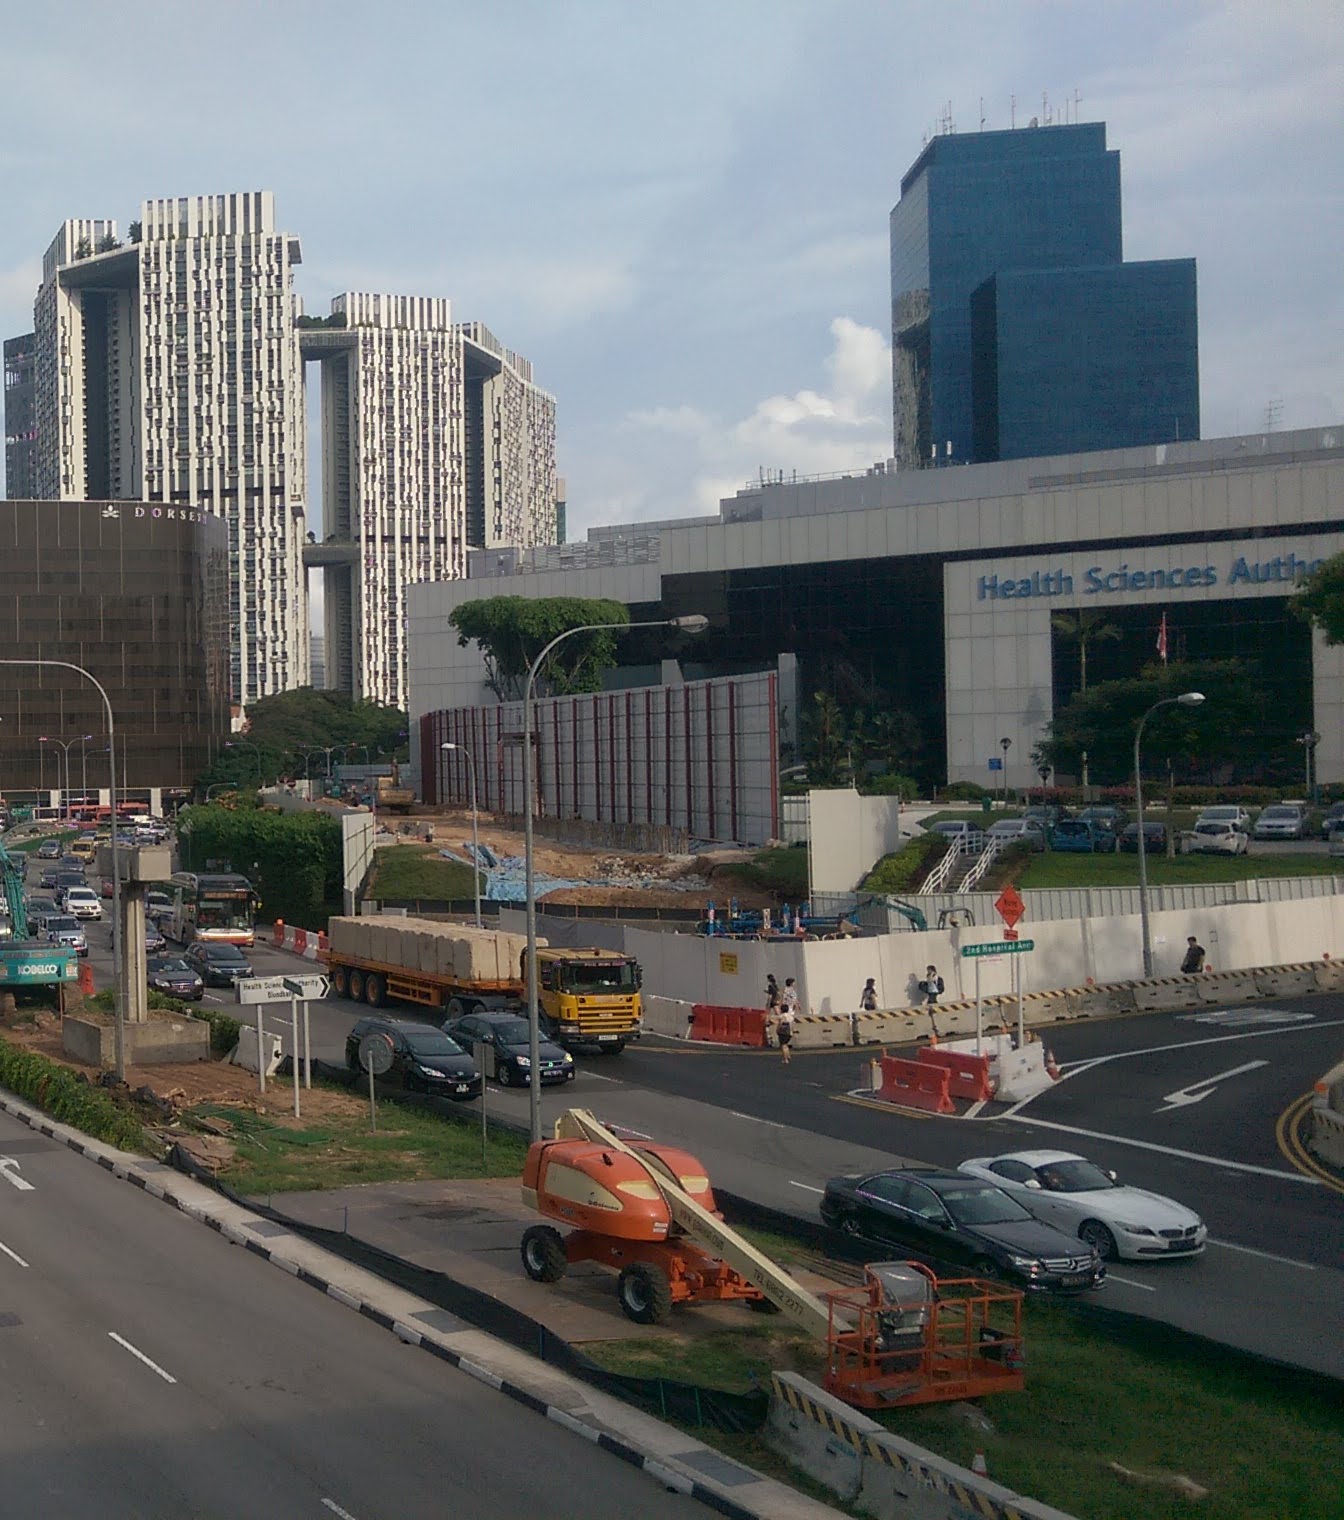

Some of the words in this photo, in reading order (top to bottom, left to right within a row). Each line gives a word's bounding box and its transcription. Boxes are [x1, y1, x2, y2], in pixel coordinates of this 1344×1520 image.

[978, 568, 1073, 600] Health
[1083, 564, 1218, 595] Sciences
[982, 944, 1015, 952] Hospital
[18, 964, 57, 975] KOBELCO
